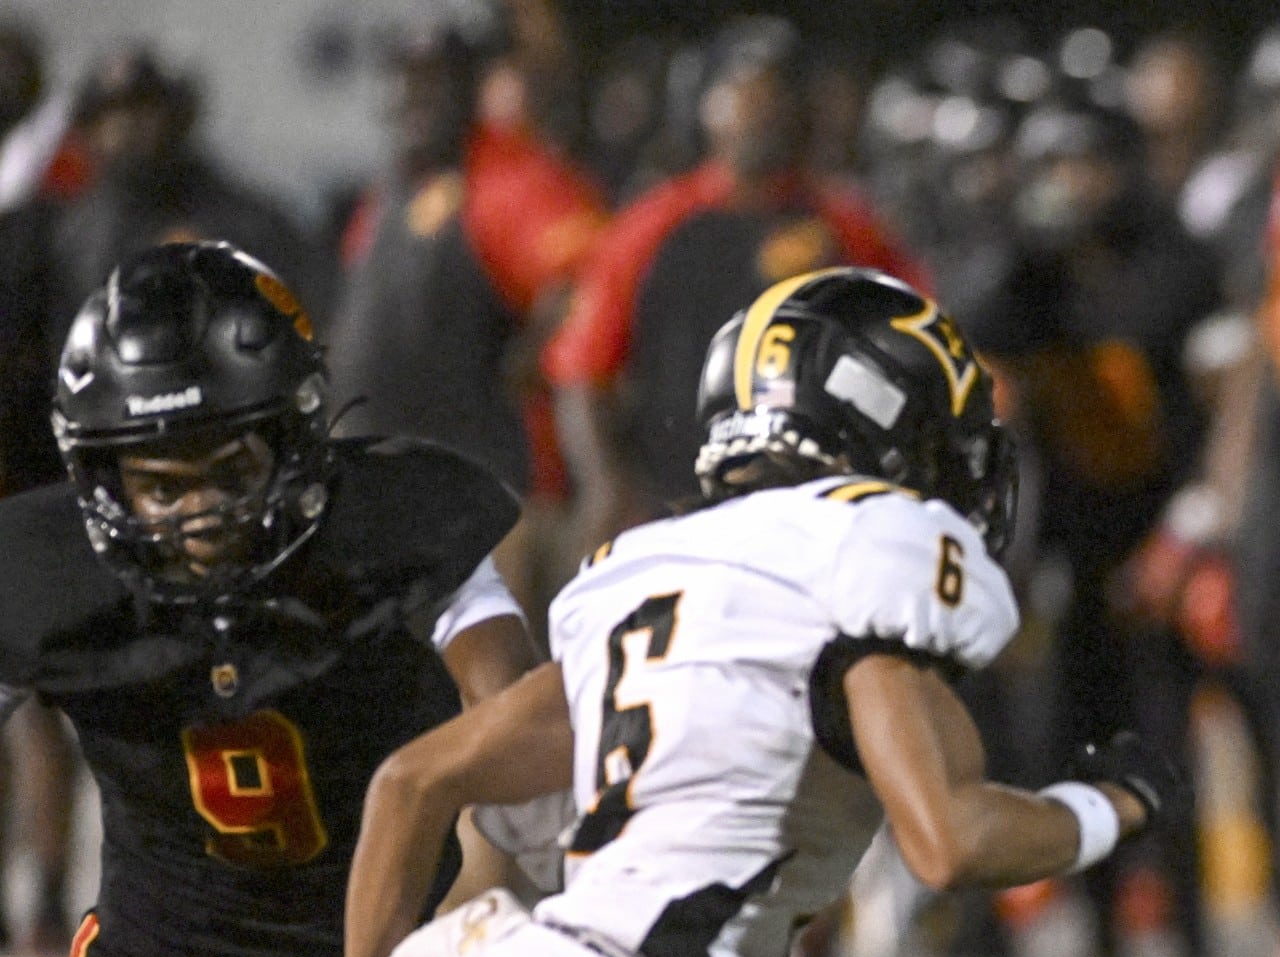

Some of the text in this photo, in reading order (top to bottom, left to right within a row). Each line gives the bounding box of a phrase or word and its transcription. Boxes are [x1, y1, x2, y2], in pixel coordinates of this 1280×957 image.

[757, 323, 796, 378] 6
[937, 534, 964, 607] 6
[564, 588, 684, 857] 6
[181, 708, 328, 864] 9
